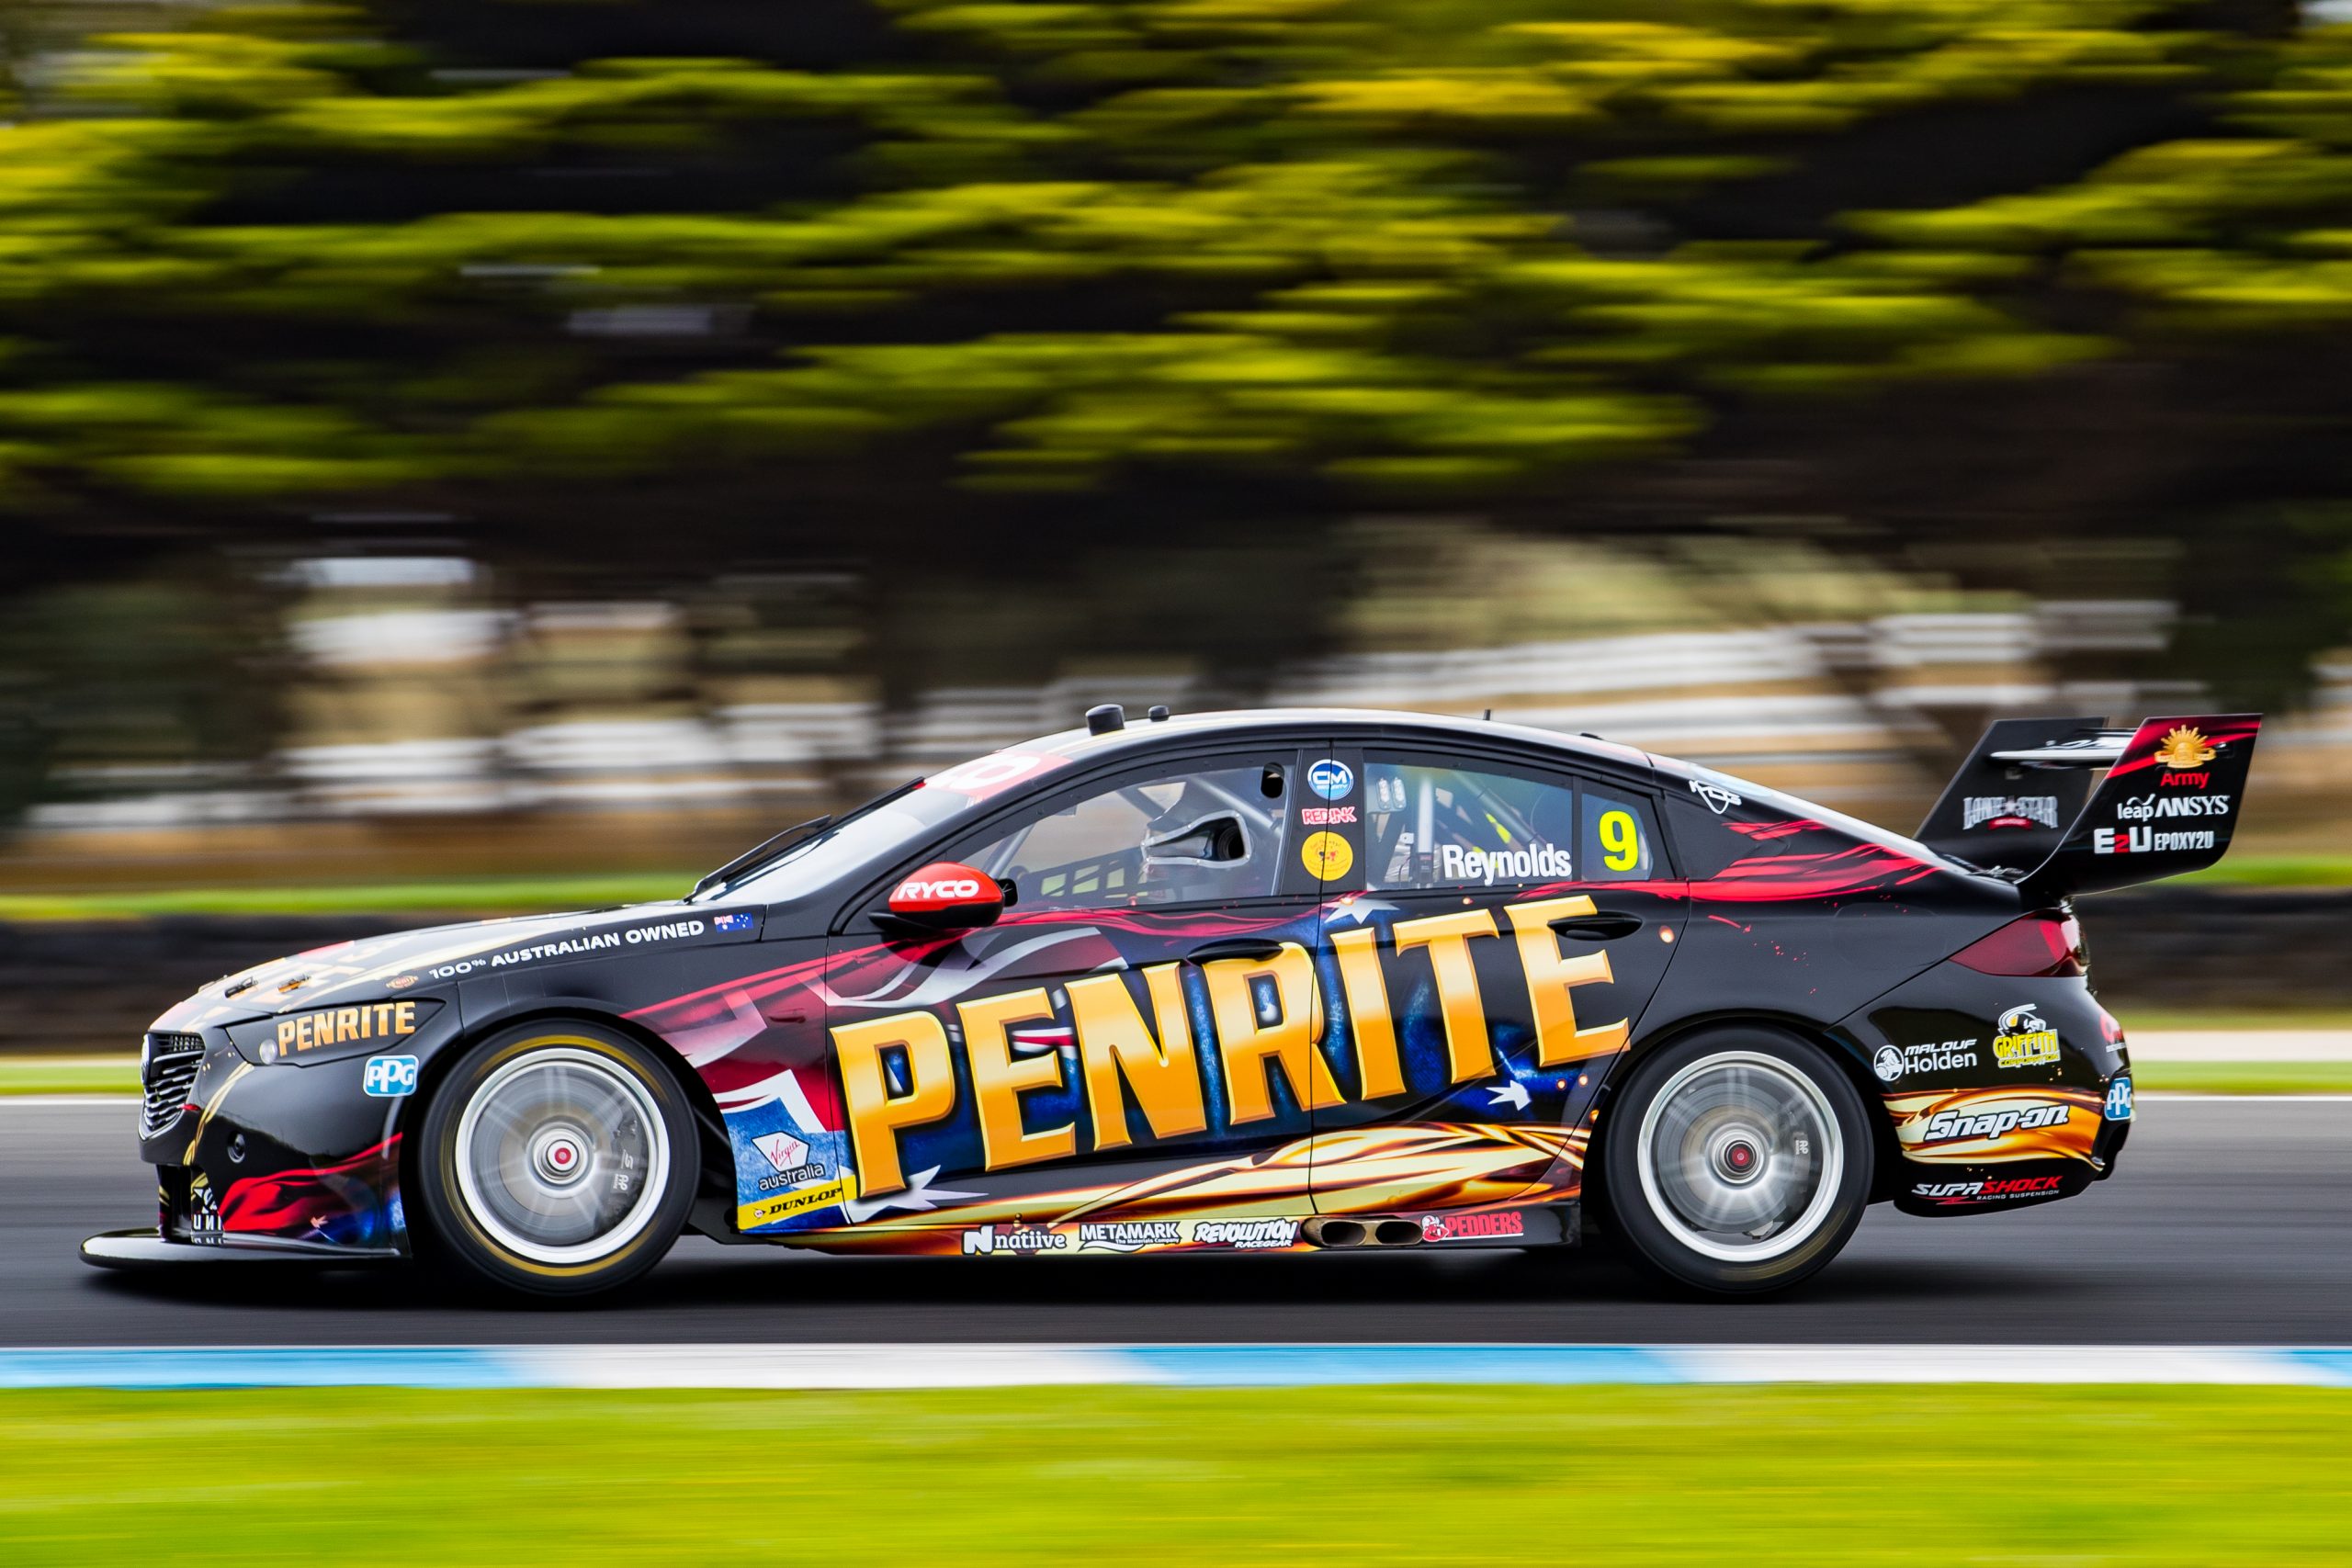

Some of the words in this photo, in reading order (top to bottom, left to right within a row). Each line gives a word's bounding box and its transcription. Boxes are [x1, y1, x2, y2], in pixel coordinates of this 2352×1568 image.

[1312, 770, 1348, 785] CM
[2160, 772, 2211, 789] Army
[2017, 795, 2058, 829] STAR
[2117, 798, 2155, 822] leap
[2155, 795, 2230, 818] ANSYS
[1599, 810, 1639, 872] 9
[2094, 826, 2152, 854] E2U
[2154, 830, 2215, 852] EPOXY2U
[1442, 842, 1572, 886] Reynolds
[898, 879, 979, 900] RYCO
[428, 958, 486, 979] 100%
[491, 931, 621, 966] AUSTRALIAN
[625, 920, 705, 944] OWNED
[277, 1001, 416, 1056] PENRITE
[830, 894, 1630, 1198] PENRITE
[1905, 1039, 1977, 1056] MALOUF
[1994, 1030, 2057, 1058] GRIFFITH
[368, 1060, 414, 1092] PPG
[1905, 1051, 1978, 1075] Holden
[771, 1139, 800, 1167] Virgin
[758, 1164, 825, 1190] australia
[1911, 1175, 2064, 1197] SUPASHOCK
[769, 1187, 842, 1215] DUNLOP
[2009, 1190, 2060, 1199] SUSPENSION
[1080, 1223, 1180, 1241] METAMARK
[1194, 1219, 1298, 1244] REVOLUTION
[1444, 1212, 1524, 1237] PEDDERS
[995, 1231, 1067, 1249] natiive
[1234, 1239, 1293, 1248] RACEGEAR
